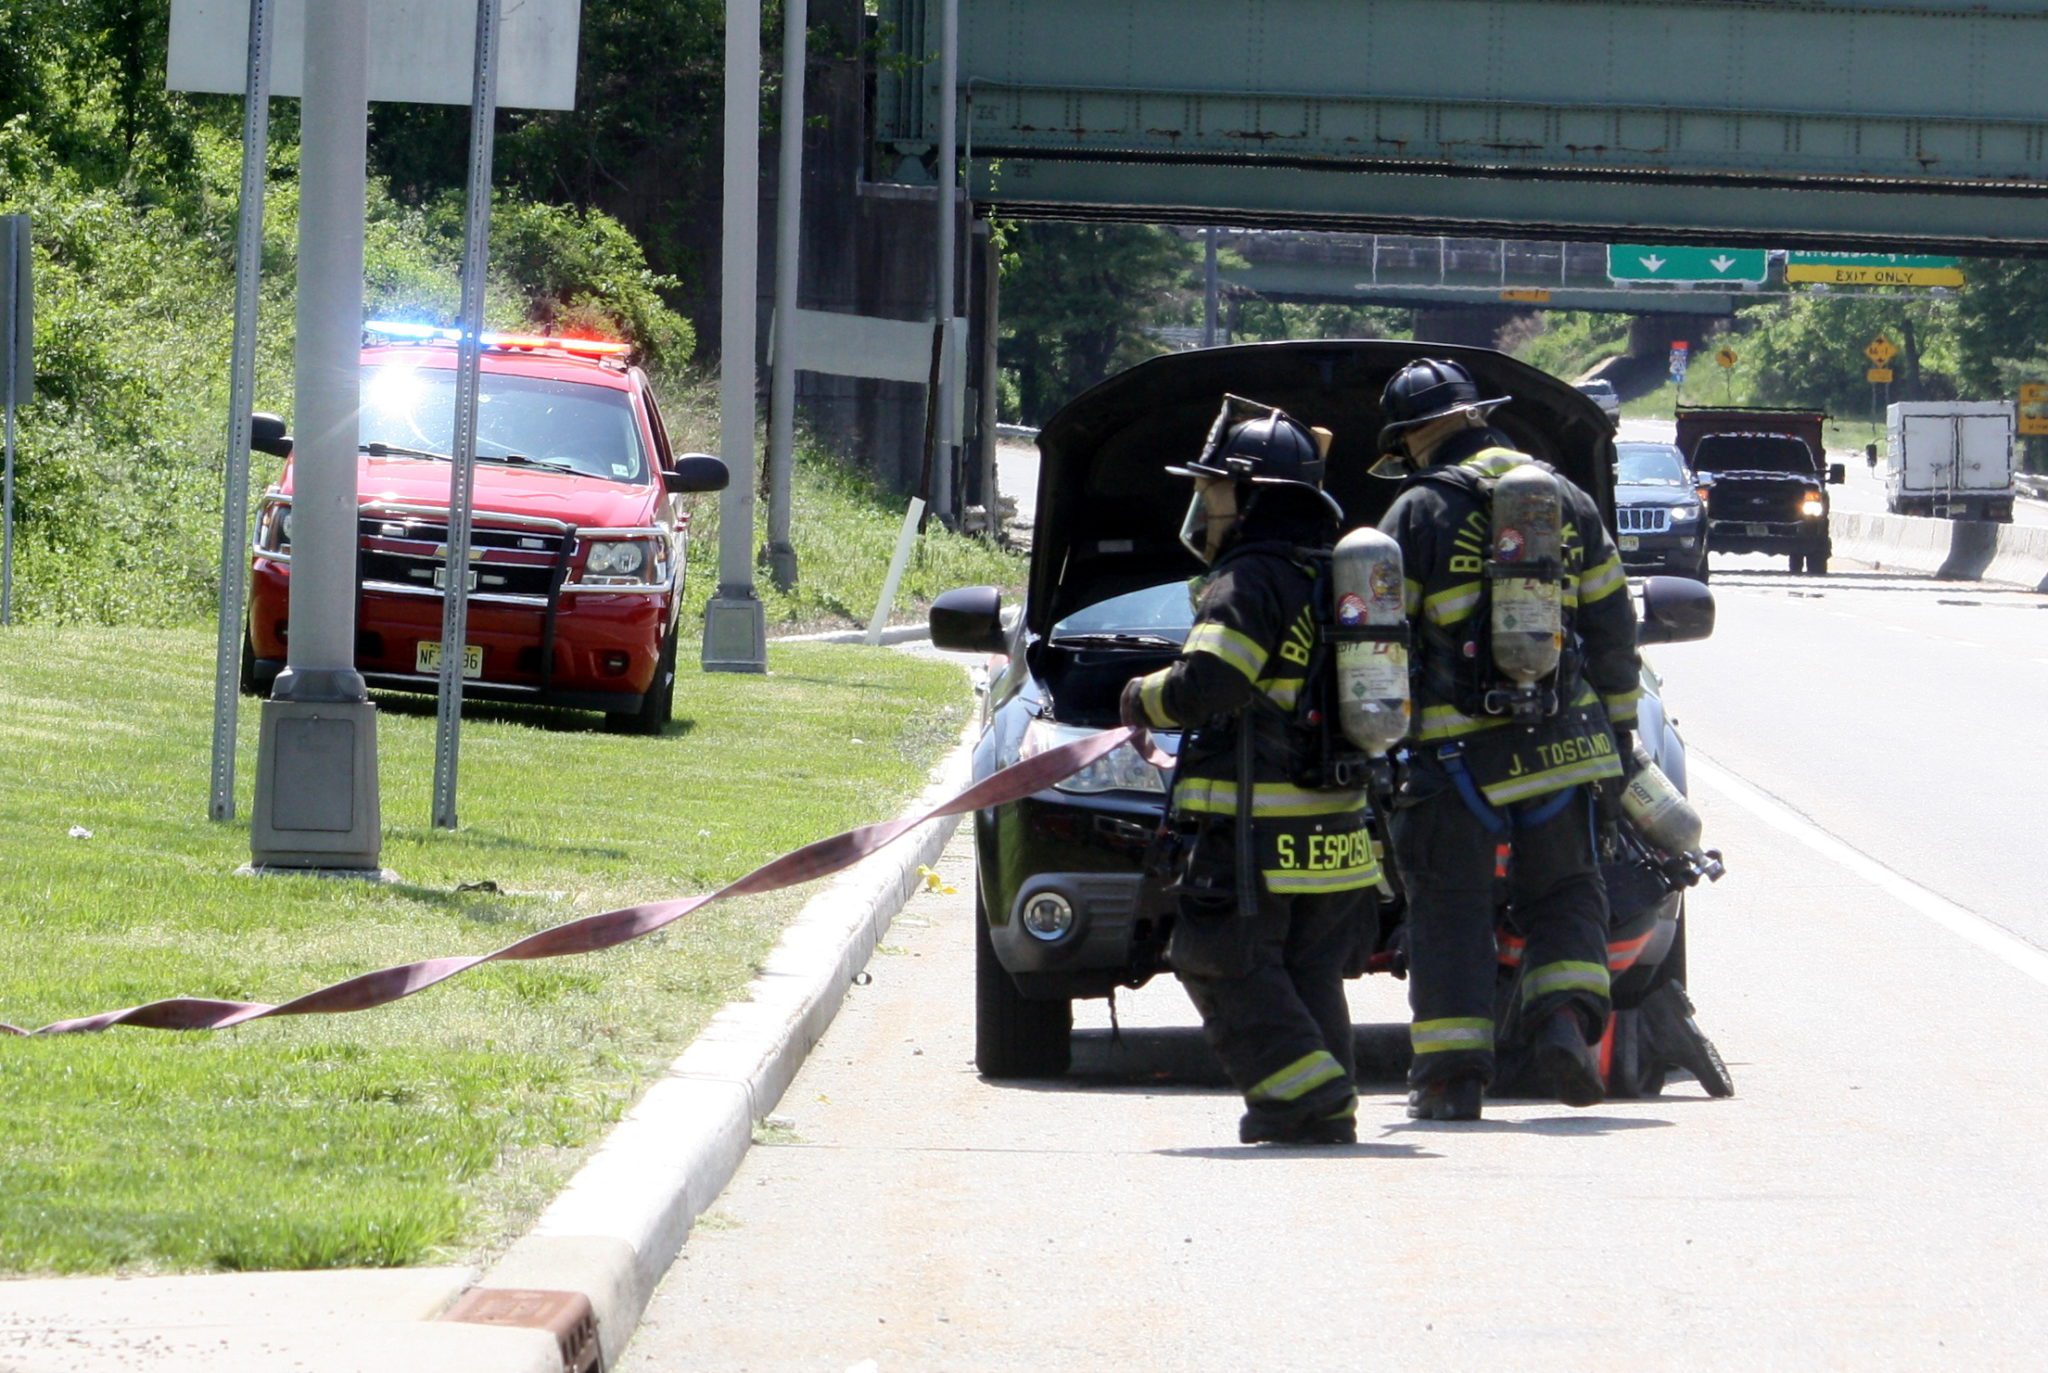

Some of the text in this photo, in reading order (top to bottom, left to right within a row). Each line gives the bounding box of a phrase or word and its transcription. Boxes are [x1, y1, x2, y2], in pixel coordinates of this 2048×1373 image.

[1835, 269, 1914, 283] EXIT ONLY
[1630, 782, 1655, 805] SCOTT
[1277, 833, 1301, 869] S.
